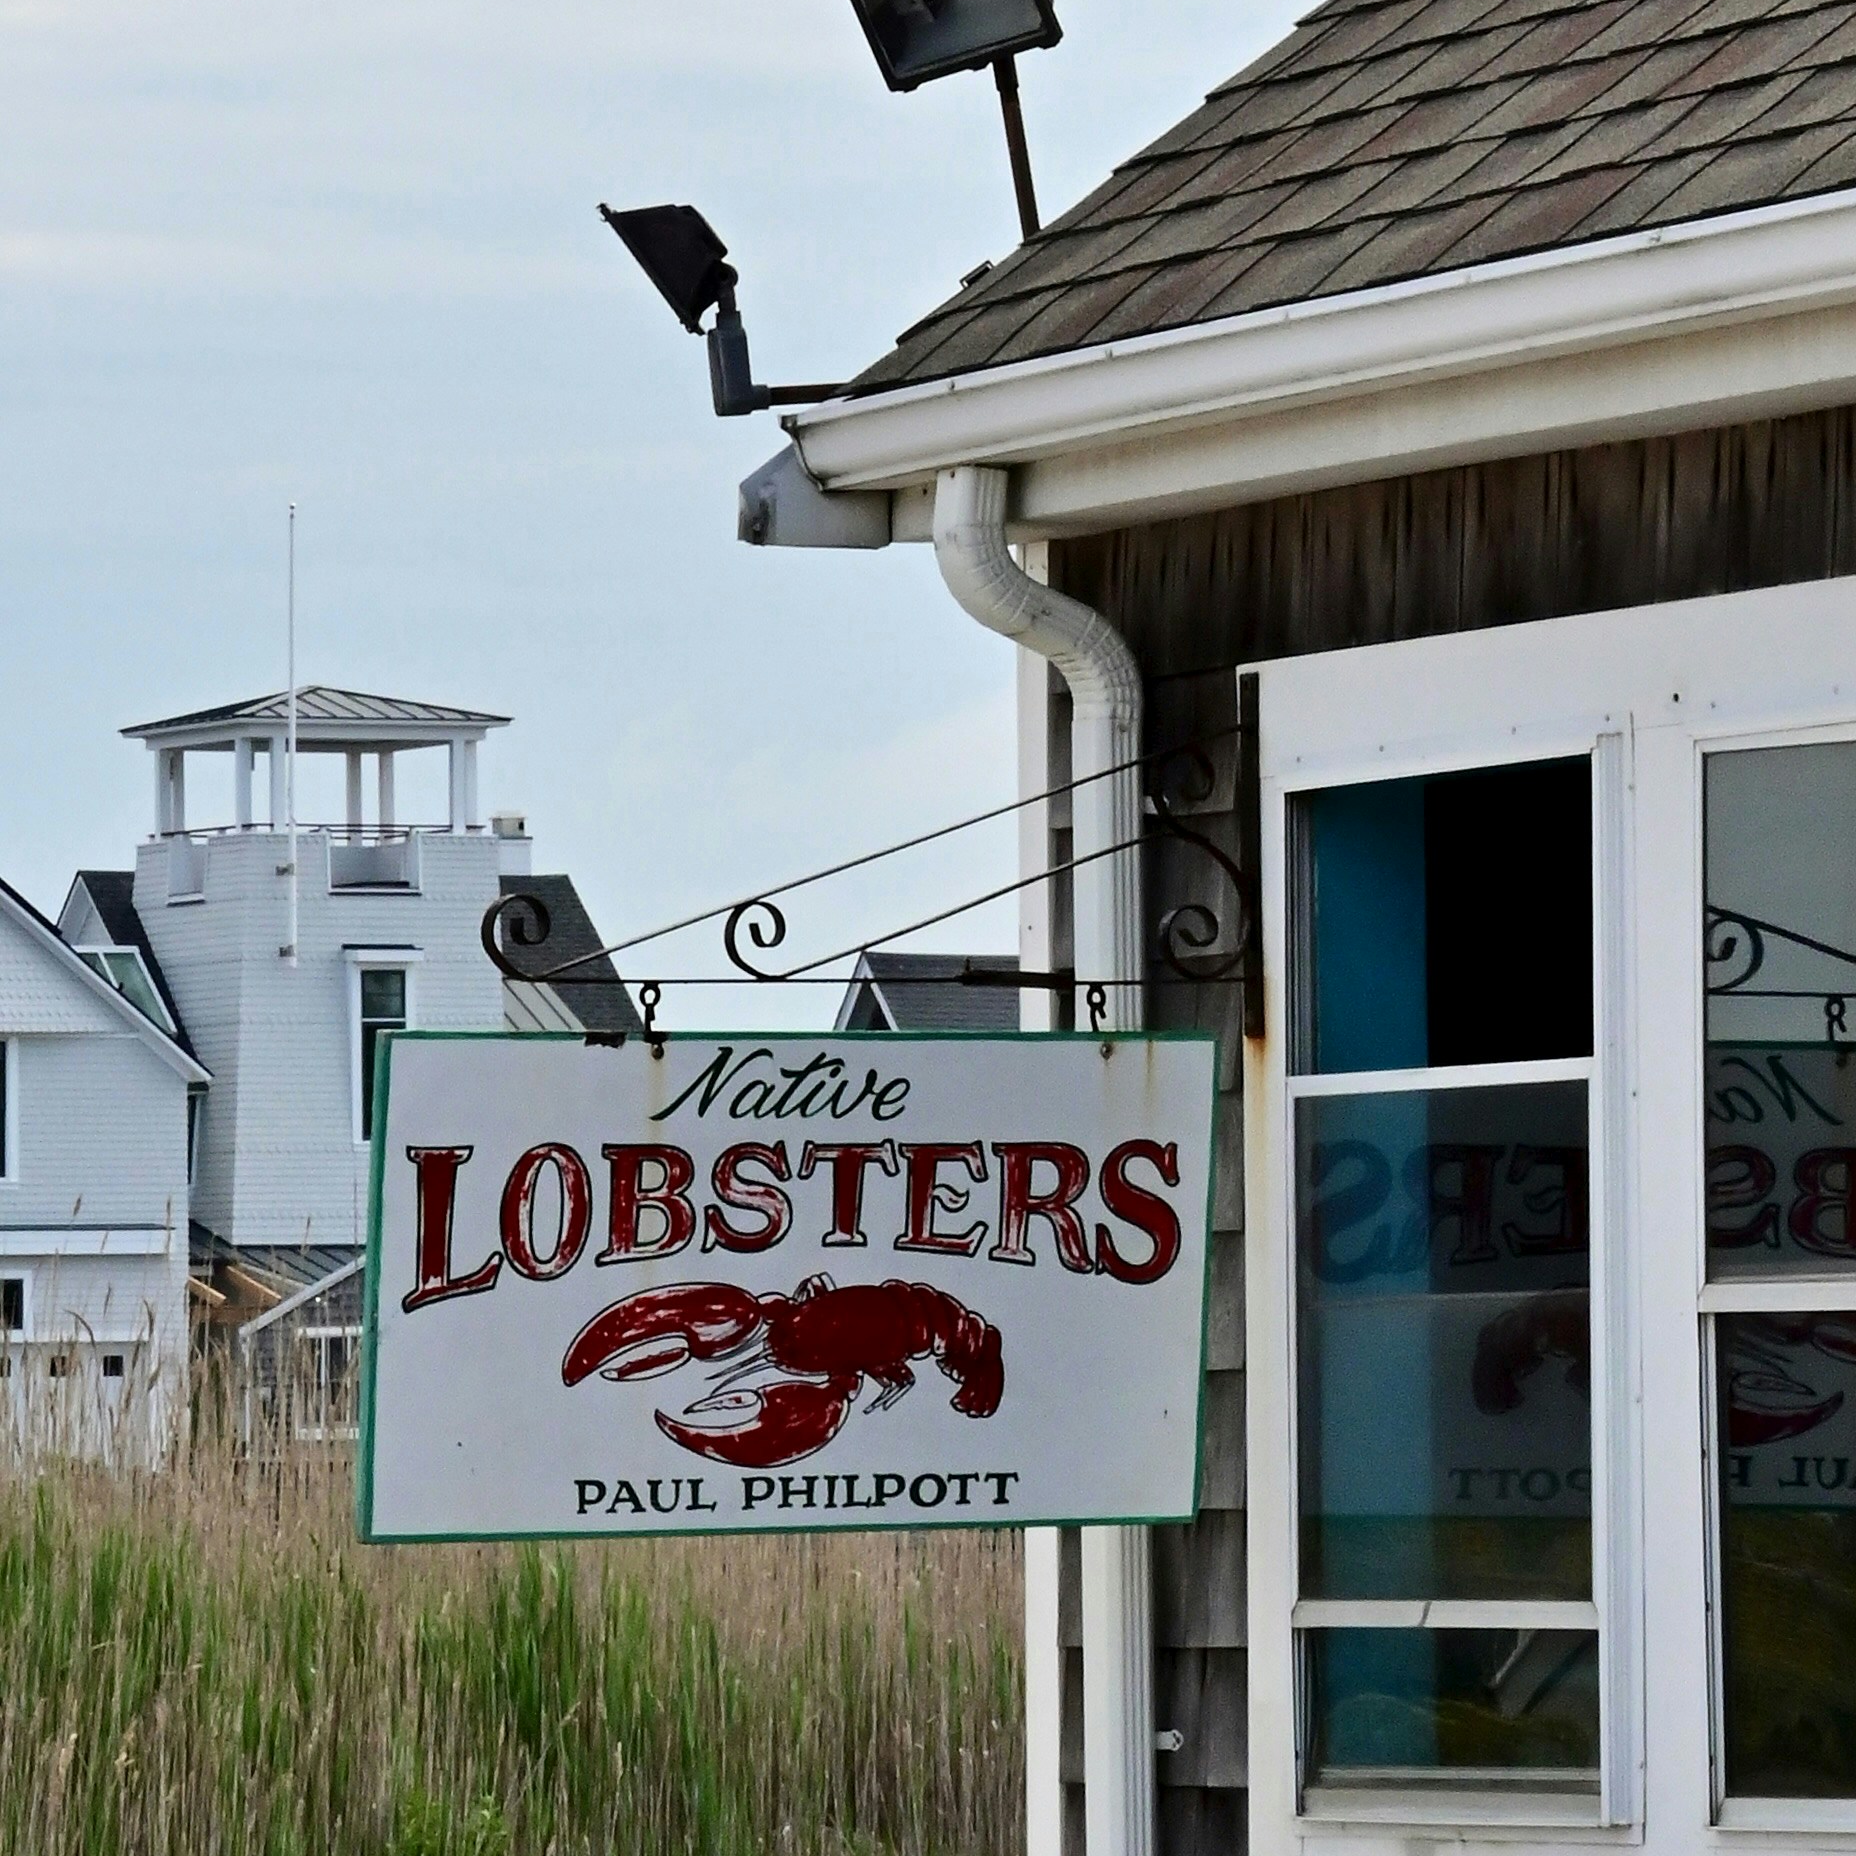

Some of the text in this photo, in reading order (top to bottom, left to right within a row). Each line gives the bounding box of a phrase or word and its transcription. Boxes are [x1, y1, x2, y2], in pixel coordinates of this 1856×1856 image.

[650, 1046, 912, 1121] Native
[402, 1138, 1182, 1312] LOBSTERS
[575, 1470, 1020, 1515] PAUL PHILPOTT
